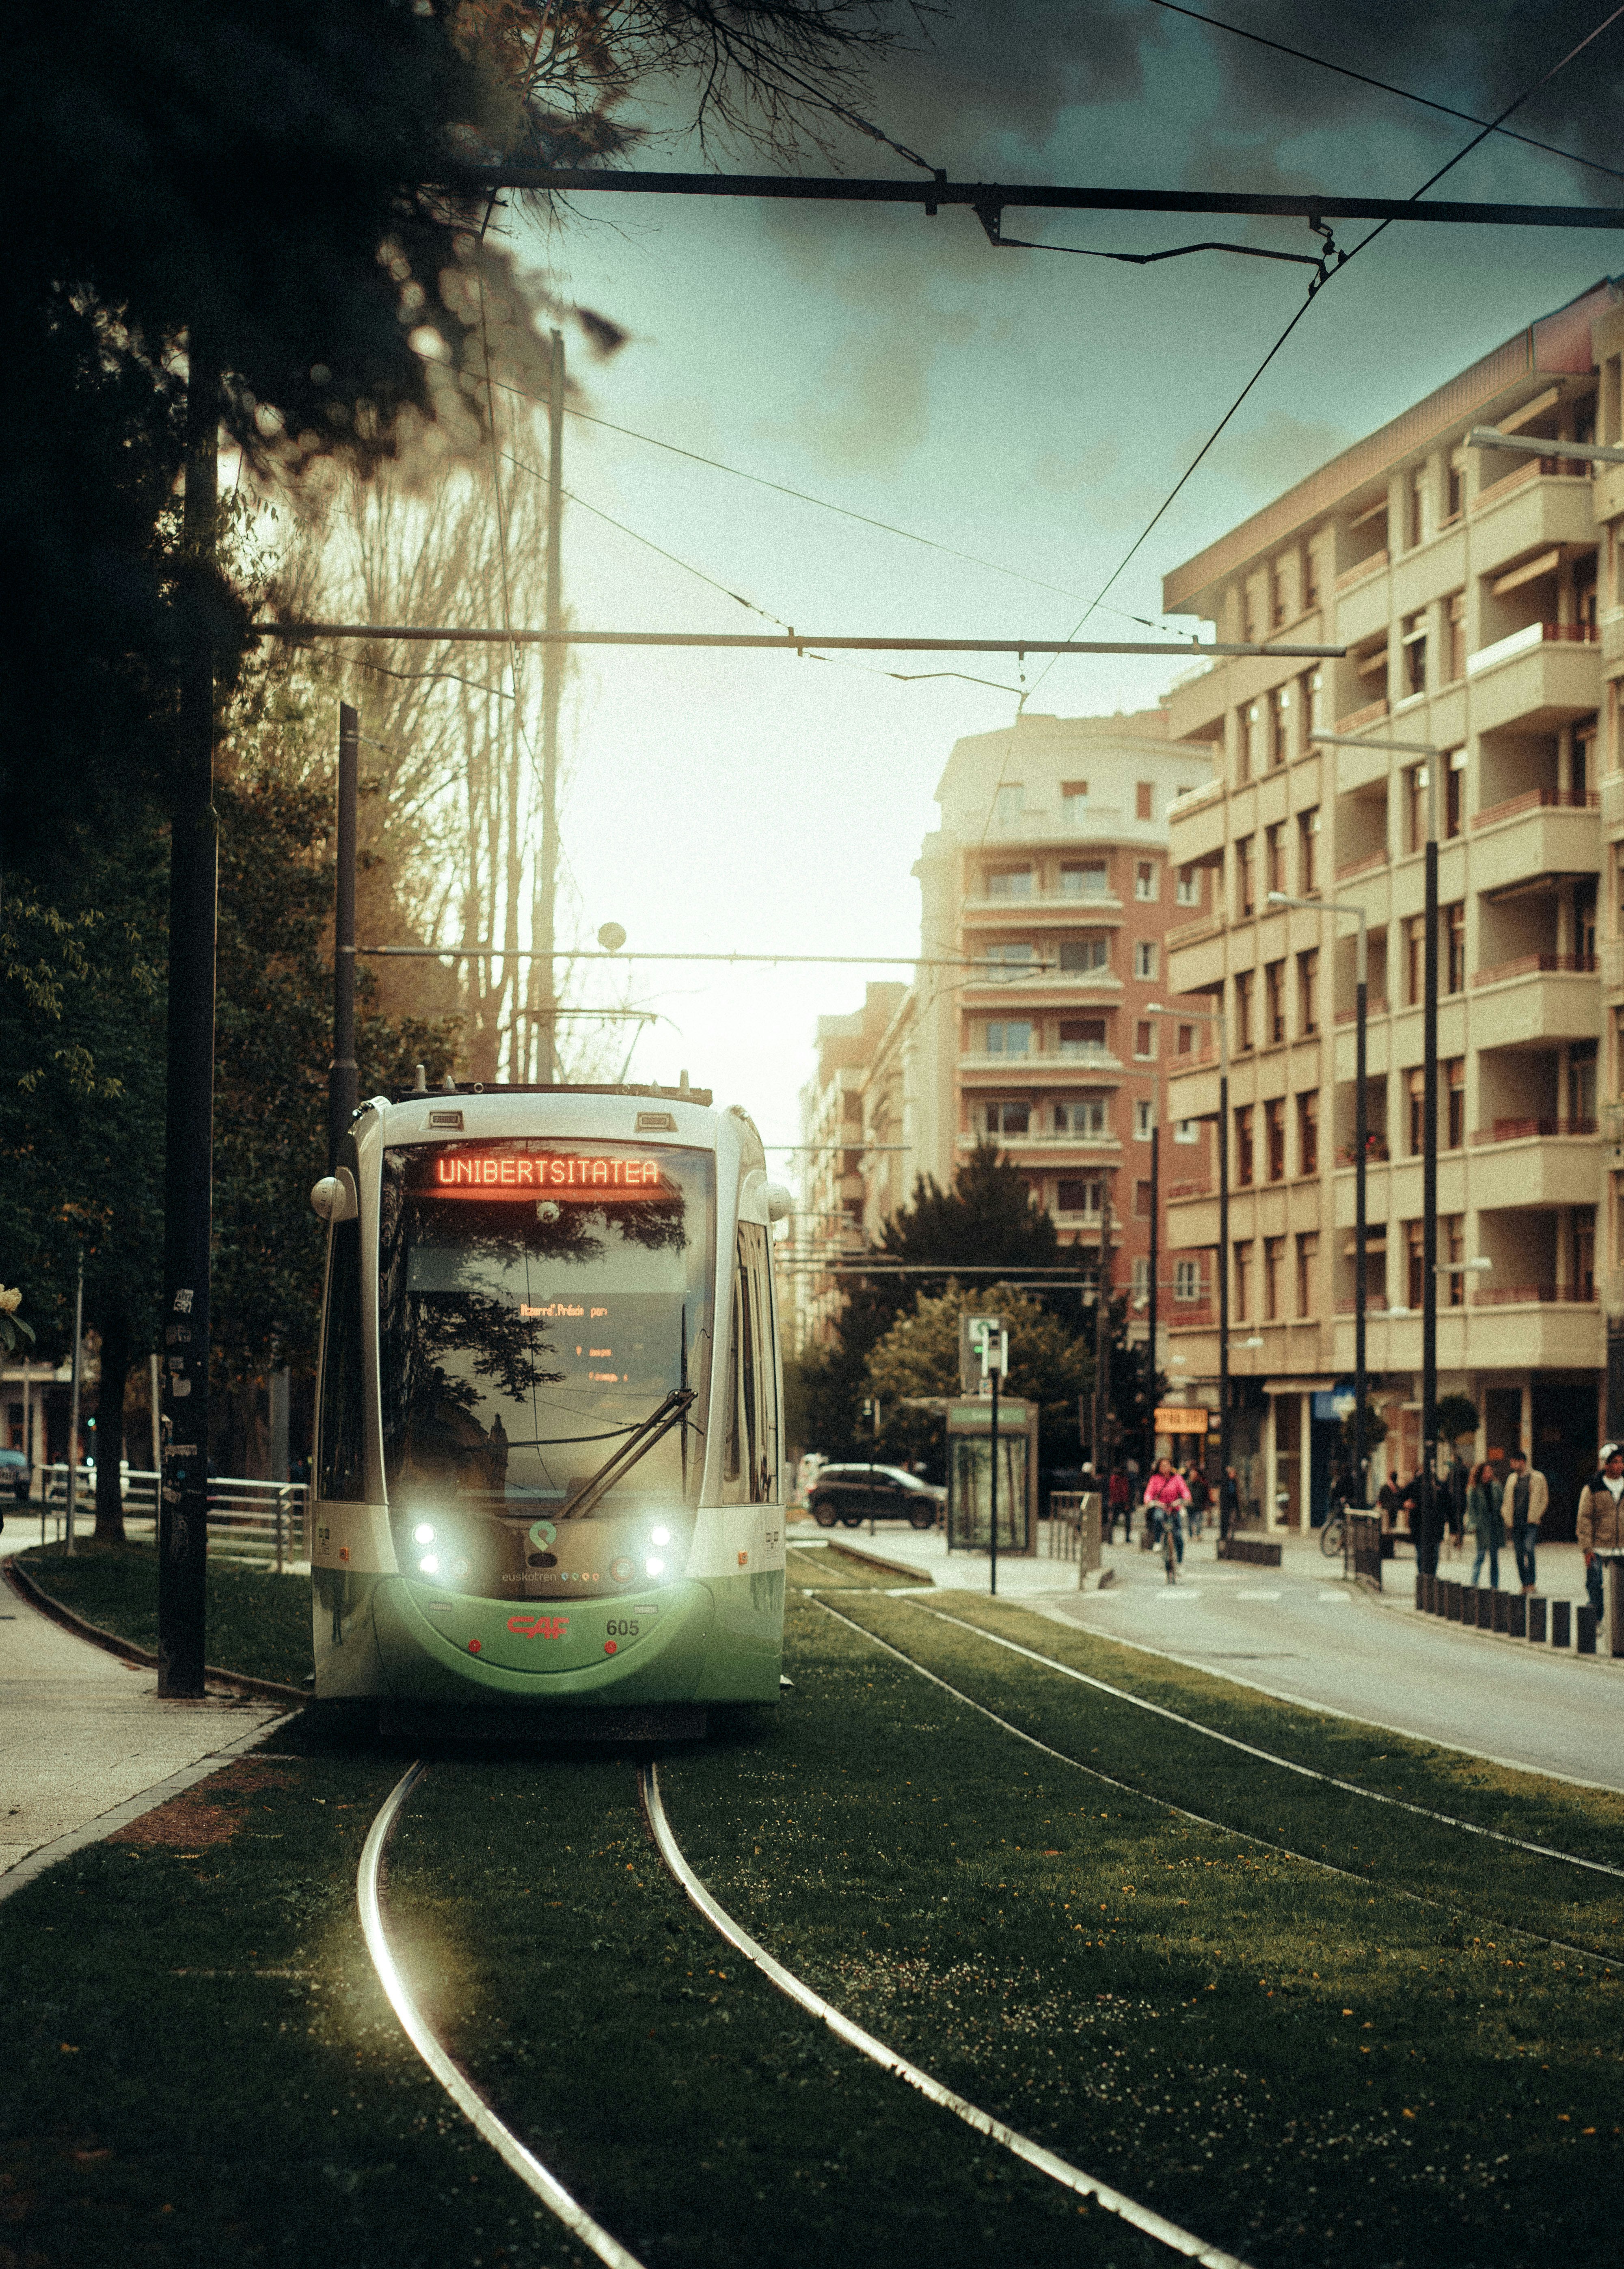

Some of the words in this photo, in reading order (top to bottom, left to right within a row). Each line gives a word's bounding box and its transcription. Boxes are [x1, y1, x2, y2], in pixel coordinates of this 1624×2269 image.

[440, 1160, 657, 1183] UNIBERTSITATEA
[502, 1572, 557, 1581] euskotren
[507, 1616, 570, 1639] CAF
[607, 1619, 639, 1636] 605
